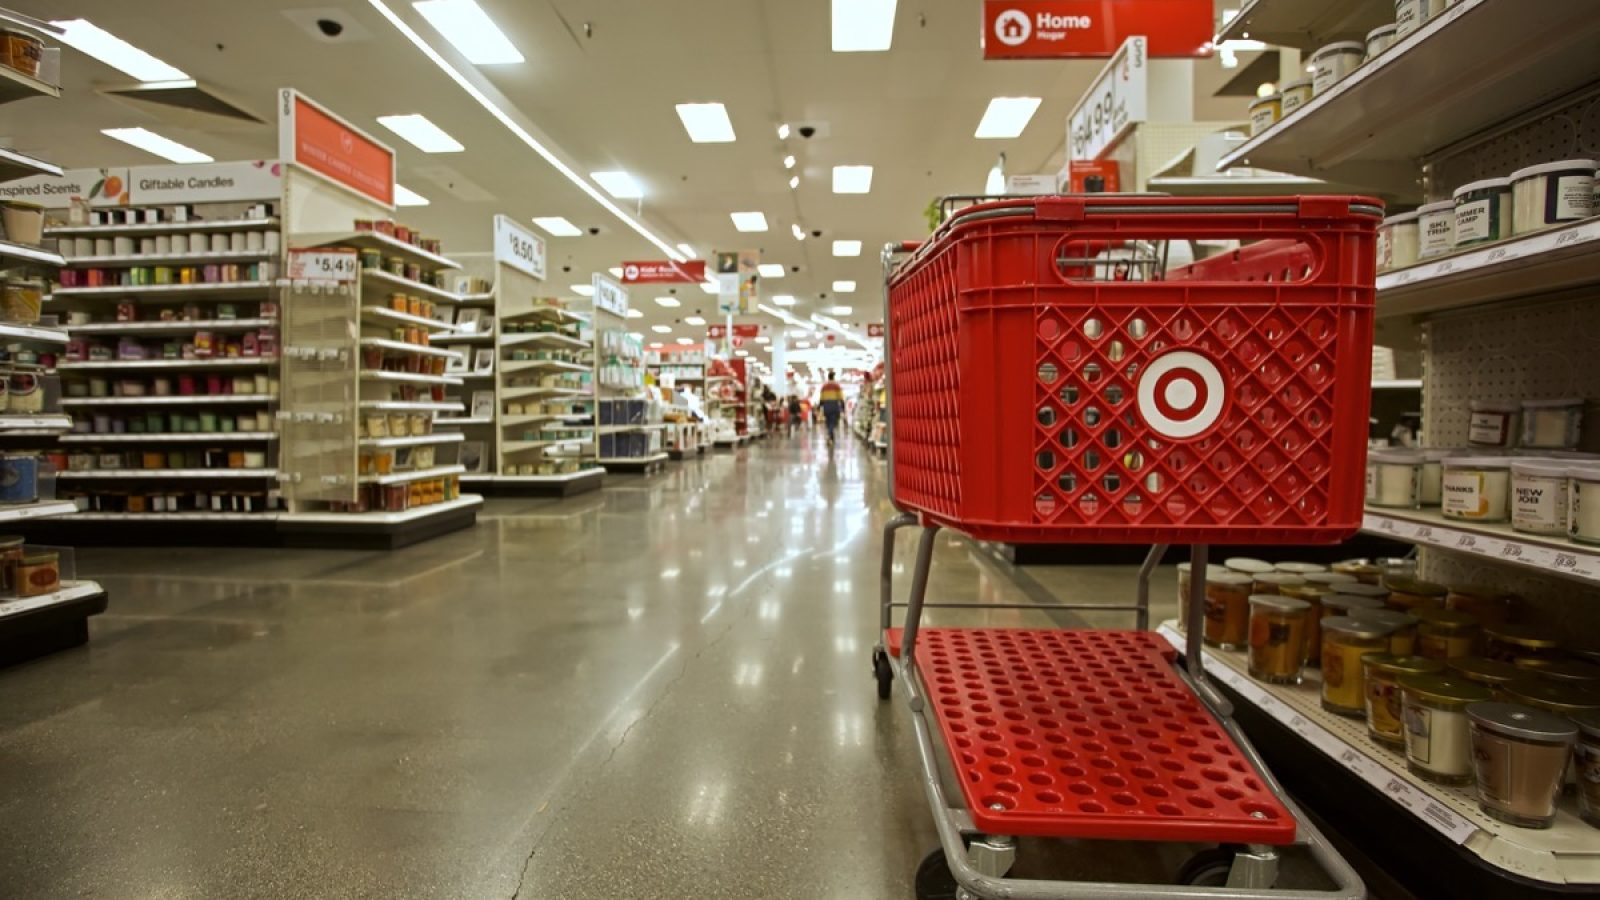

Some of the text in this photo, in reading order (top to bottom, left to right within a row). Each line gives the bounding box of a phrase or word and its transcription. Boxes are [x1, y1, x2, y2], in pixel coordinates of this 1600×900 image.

[1037, 12, 1092, 29] Home
[1037, 31, 1066, 41] Hogar
[139, 177, 235, 190] Giftable Candles
[0, 183, 81, 197] nspired Scents
[1444, 485, 1475, 494] THANKS
[1515, 487, 1543, 497] NEW
[1518, 496, 1540, 504] JOB
